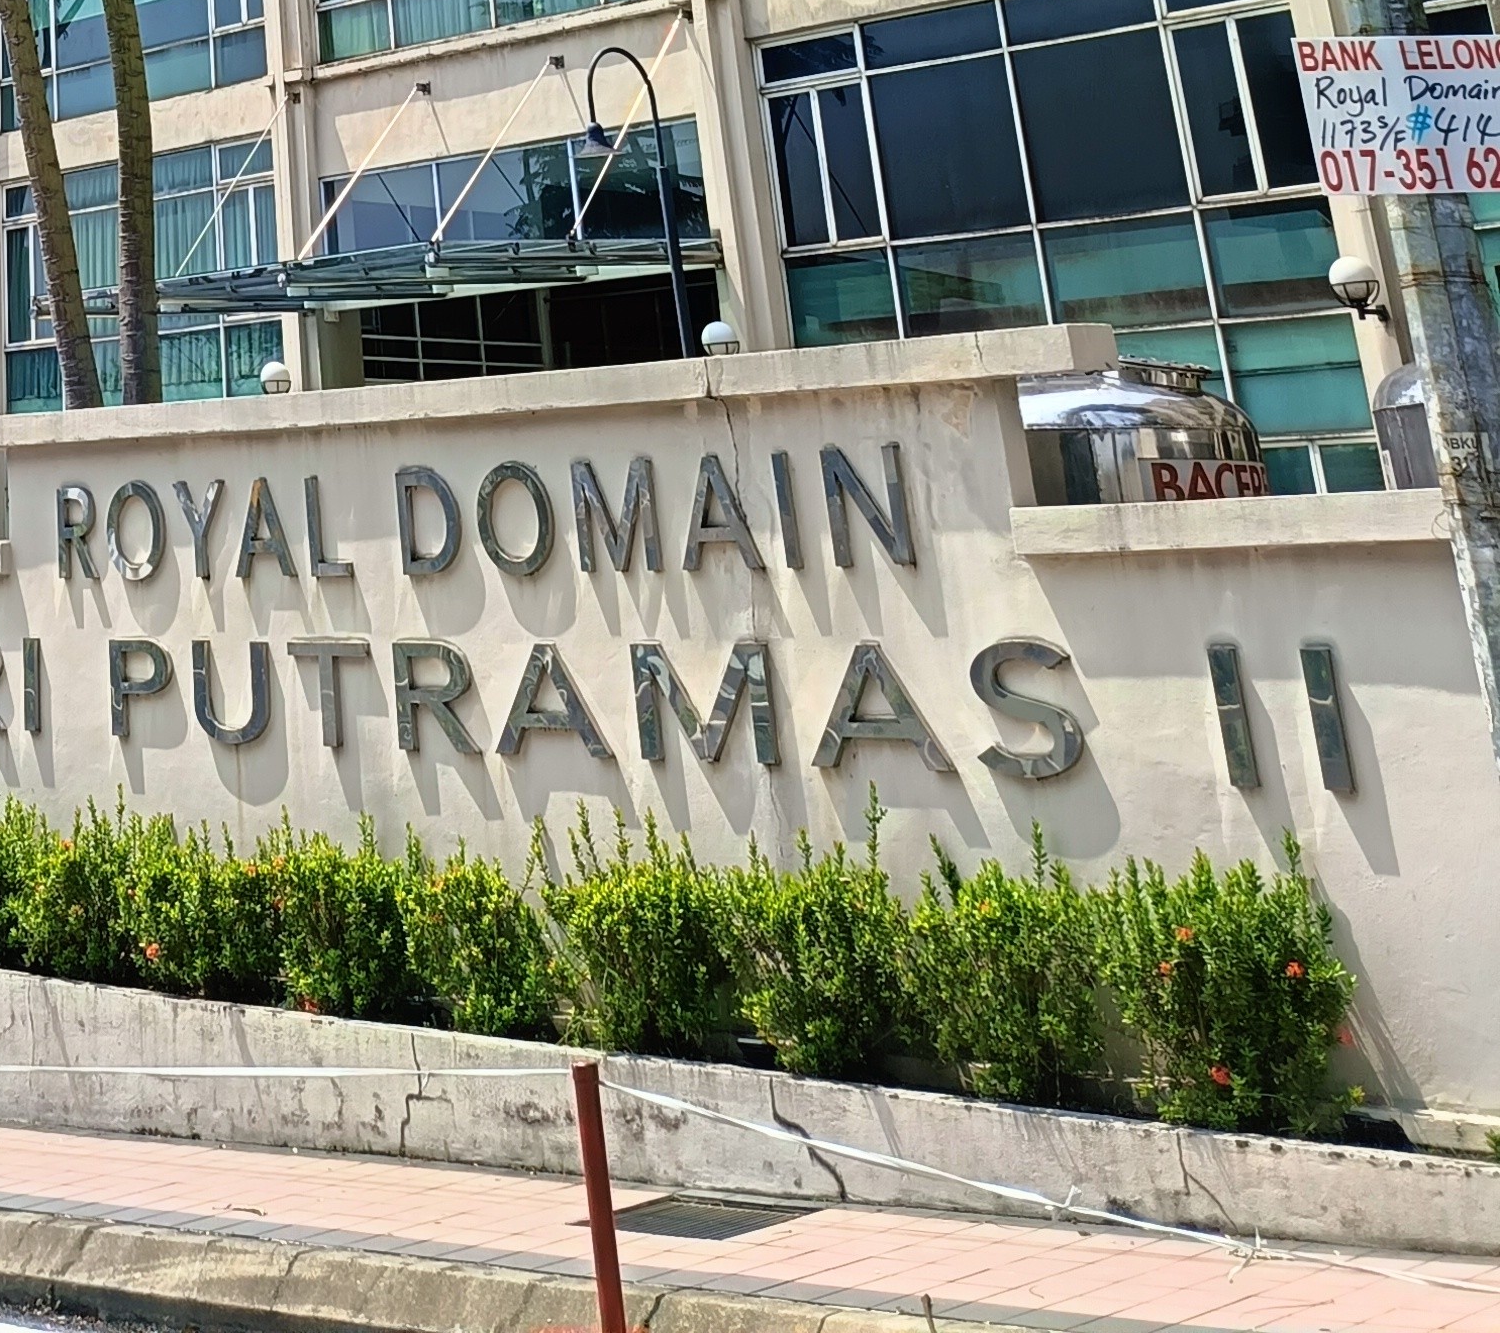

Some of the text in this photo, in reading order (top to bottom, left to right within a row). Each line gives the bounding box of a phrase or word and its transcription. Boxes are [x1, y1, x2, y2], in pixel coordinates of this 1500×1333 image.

[1297, 39, 1500, 71] BANK LELON
[1315, 75, 1387, 117] Royal
[1320, 148, 1453, 192] 017-351
[57, 441, 917, 581] ROYAL DOMAIN
[109, 635, 1087, 781] PUTRAMAS
[1206, 643, 1358, 795] II
